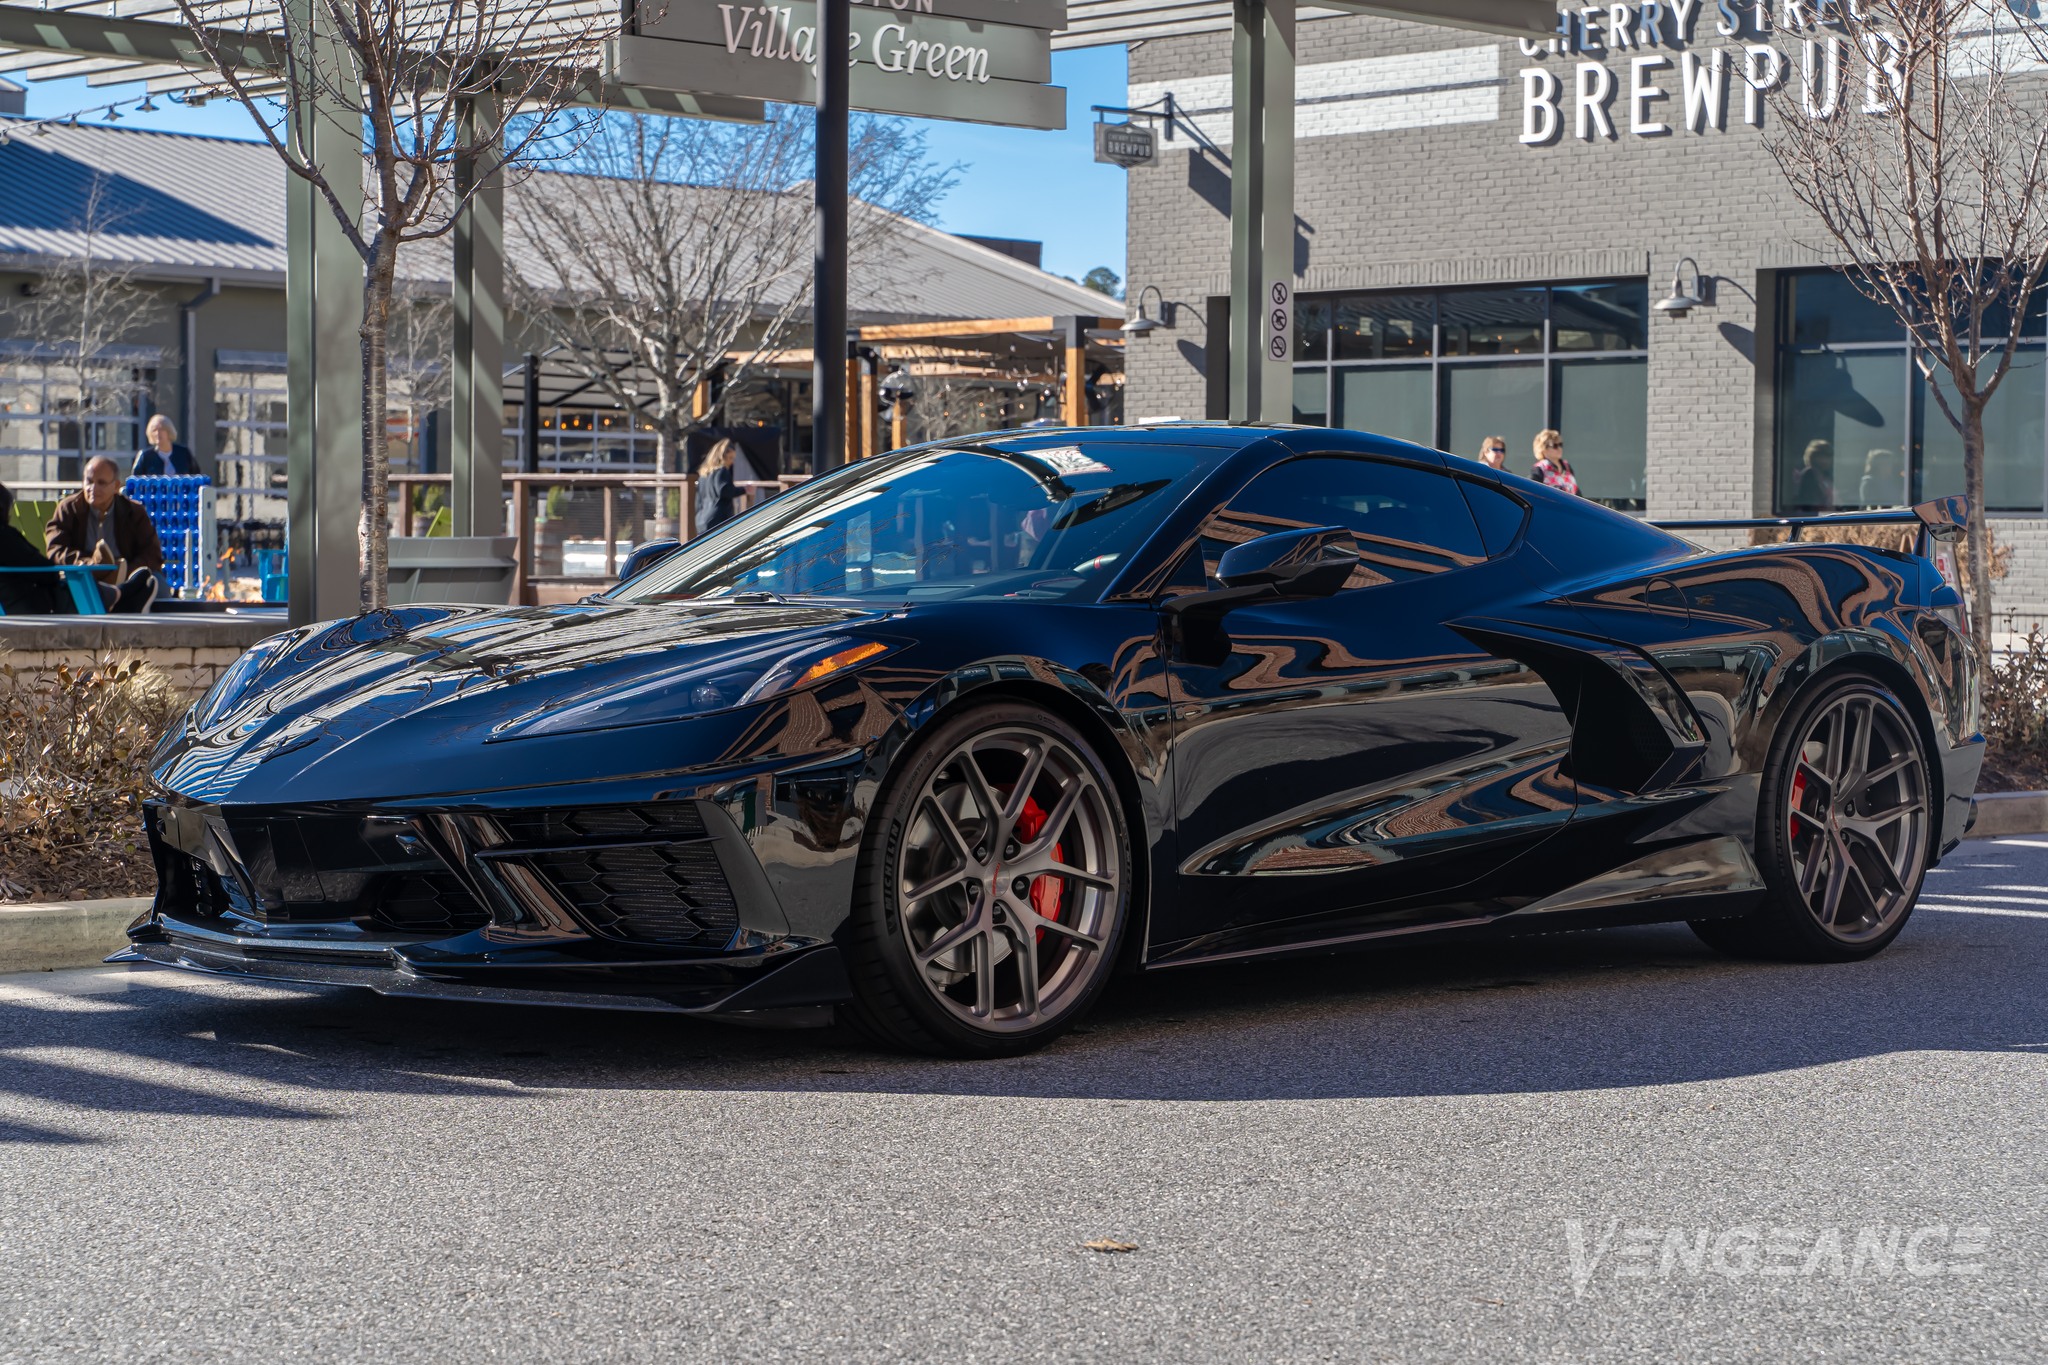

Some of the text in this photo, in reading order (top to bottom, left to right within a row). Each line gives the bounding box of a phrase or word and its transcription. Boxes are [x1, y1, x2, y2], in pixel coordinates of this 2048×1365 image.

[718, 3, 991, 84] Villae Green
[1519, 30, 1905, 144] BREWPUB
[1107, 140, 1152, 157] BREWPUB
[884, 823, 899, 910] MICHELIN
